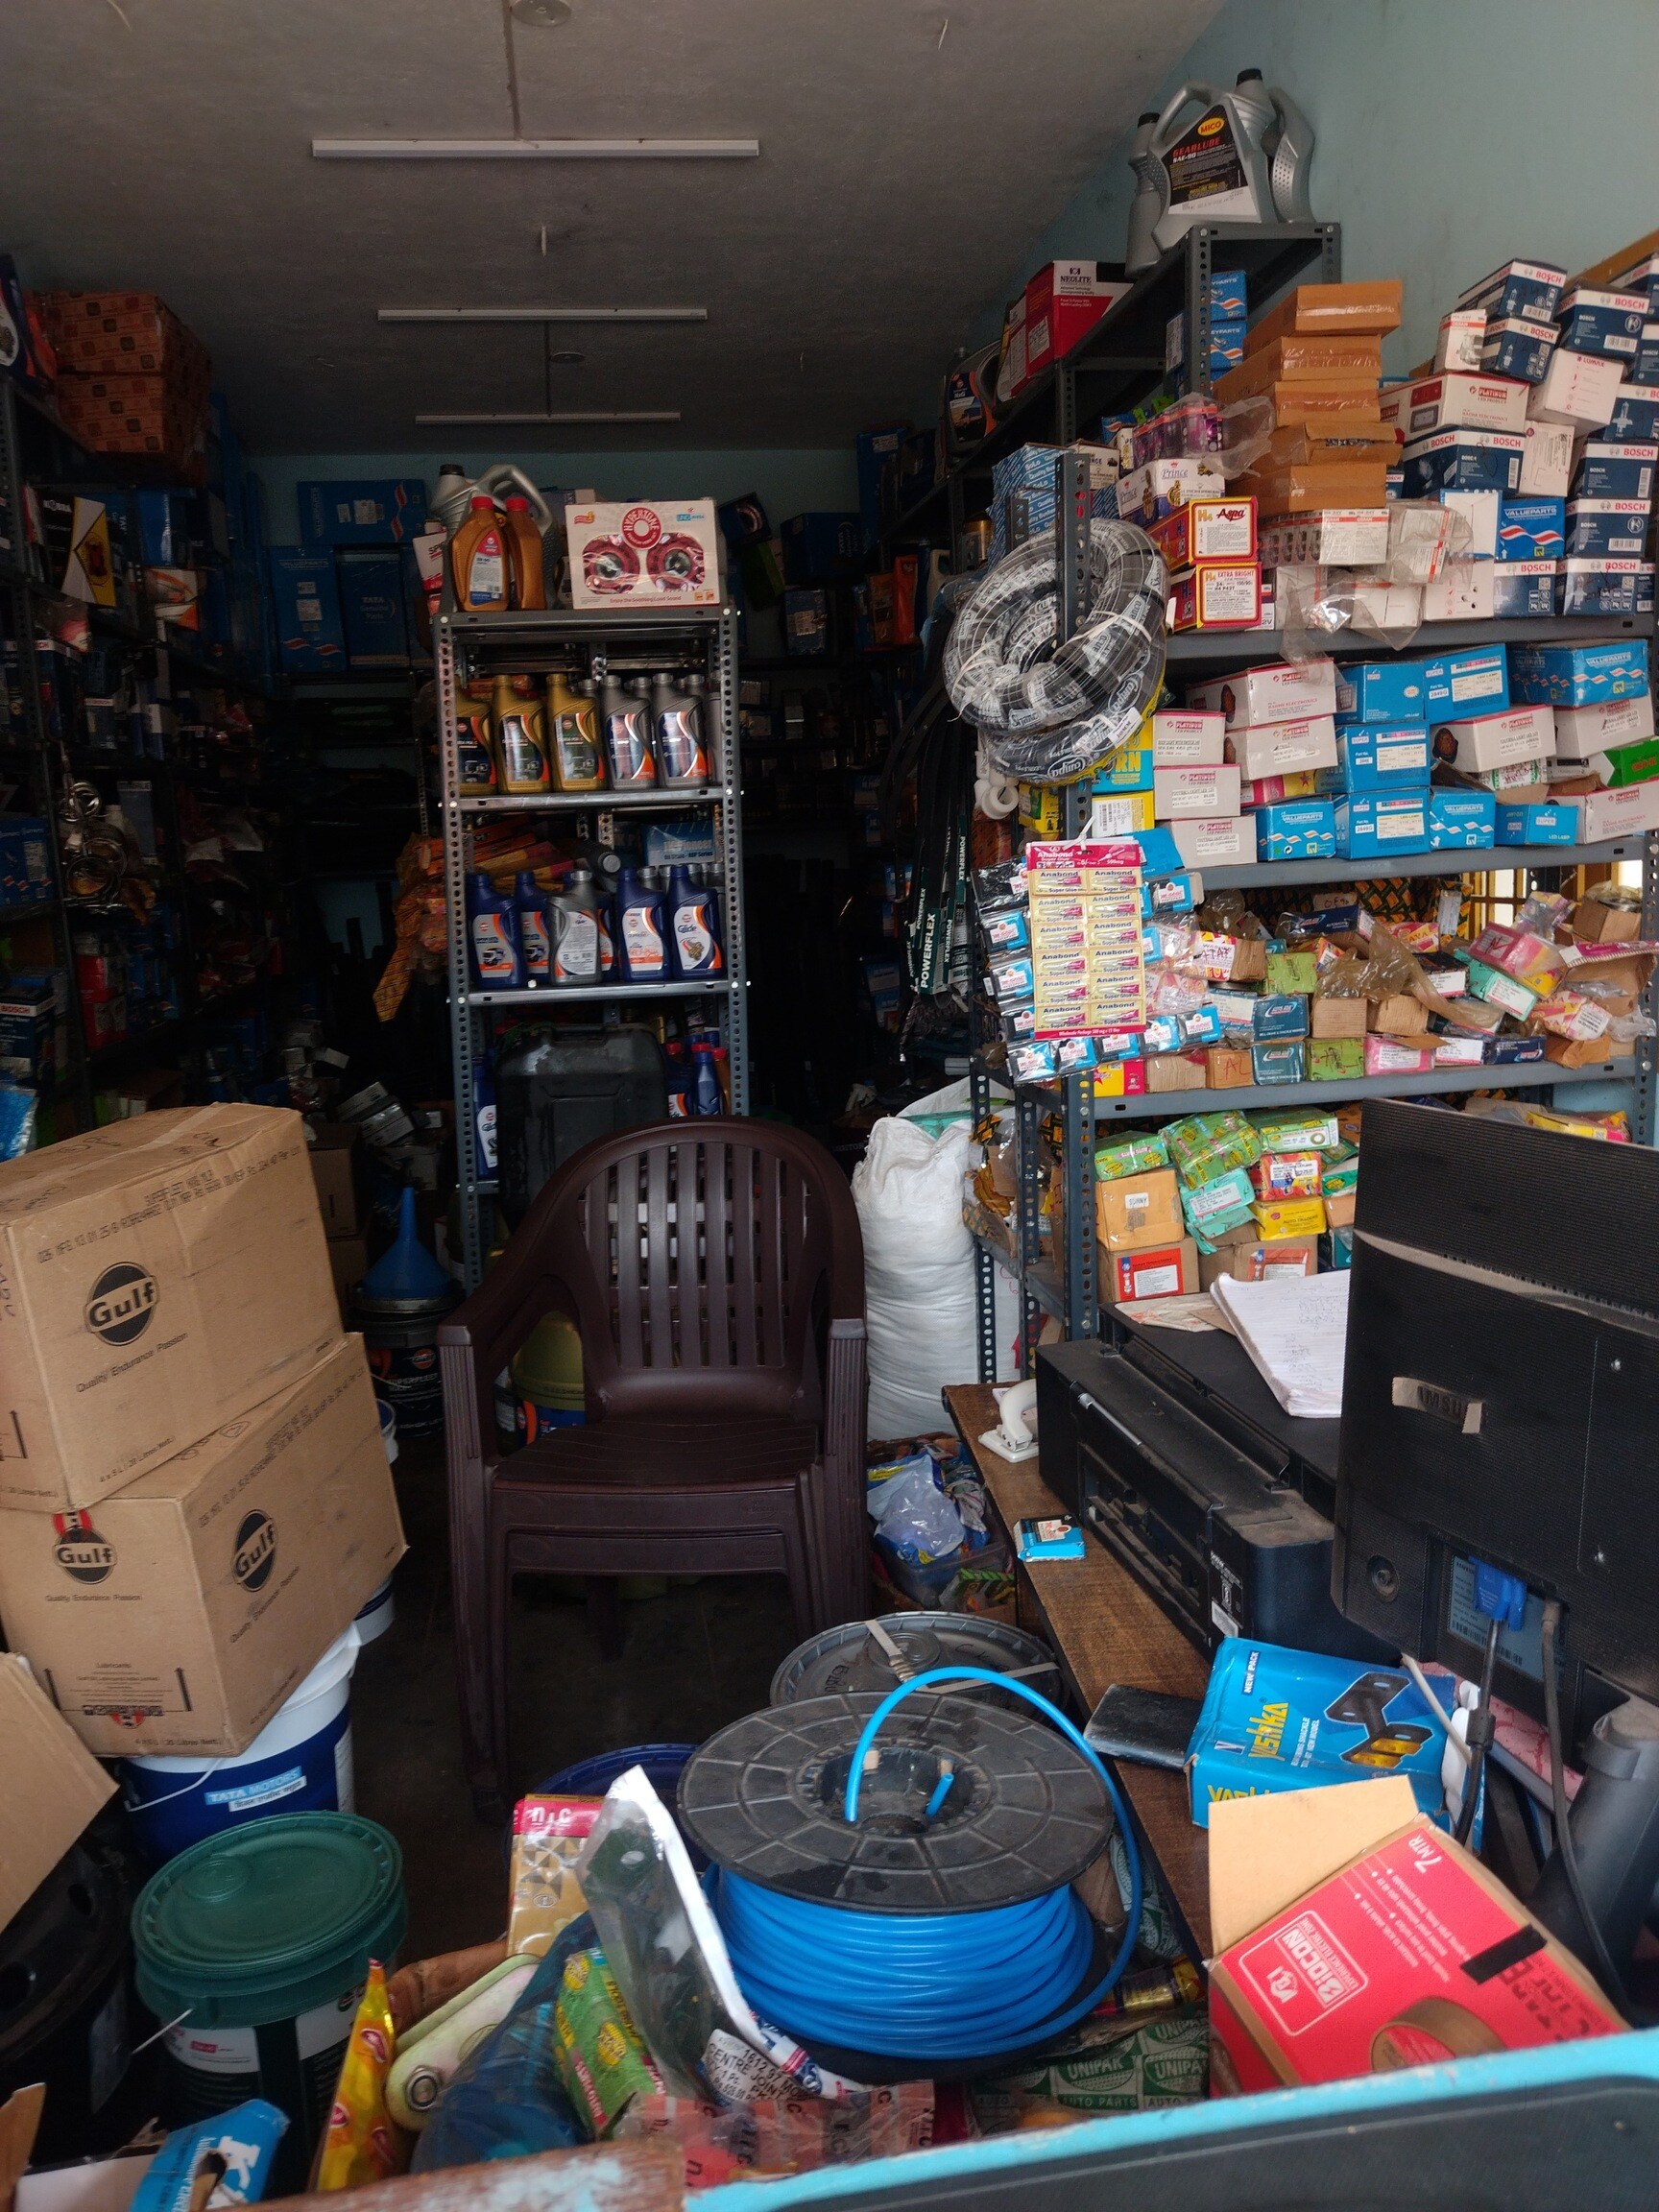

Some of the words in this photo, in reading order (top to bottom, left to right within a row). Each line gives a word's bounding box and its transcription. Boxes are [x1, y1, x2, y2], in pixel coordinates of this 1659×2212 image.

[1200, 122, 1222, 133] MICO
[1172, 136, 1221, 157] GEARLUBE
[1536, 271, 1562, 283] BOSCH
[1615, 298, 1646, 309] BOSCH
[1529, 327, 1554, 340] BOSCH
[1583, 357, 1605, 368] LUMAX
[1479, 388, 1507, 400] PLATINUM
[1431, 435, 1455, 448] BOSCH
[1493, 438, 1522, 447] BOSCH
[1623, 448, 1653, 457] BOSCH
[1025, 460, 1041, 470] SoLo
[1162, 469, 1189, 479] Prince
[1216, 508, 1245, 521] Aspa
[1504, 506, 1557, 517] VALUEPARTS
[1616, 502, 1646, 512] BOSCH
[623, 509, 661, 532] HYPERTONE
[1521, 564, 1551, 573] BOSCH
[1605, 561, 1636, 571] BOSCH
[1113, 674, 1140, 711] Campa
[1175, 720, 1203, 729] PLATINUM
[1282, 726, 1310, 735] PLATINUM
[1050, 757, 1085, 778] Campa
[1115, 752, 1142, 772] RN
[1189, 773, 1216, 781] PLATINUM
[1206, 823, 1233, 831] PLATINUM
[917, 887, 926, 930] POWERFLEX
[944, 919, 952, 963] POWERFLEX
[921, 912, 936, 989] POWERFLEX
[88, 1281, 156, 1328] Gulf
[76, 1372, 108, 1394] Quality
[110, 1349, 155, 1378] Endurance
[156, 1332, 188, 1353] Passion
[57, 1547, 113, 1565] Gulf
[235, 1525, 276, 1577] Gulf
[45, 1594, 71, 1602] Quality
[1248, 1651, 1259, 1674] PACK
[1243, 1674, 1254, 1694] NEW
[209, 1790, 248, 1803] TATA
[249, 1769, 301, 1793] MOTORS
[1408, 1835, 1434, 1861] MTR
[1414, 1855, 1442, 1873] 7
[1299, 1917, 1316, 1936] ZONE
[1309, 1931, 1334, 1959] ELECTRIC
[1328, 1954, 1360, 1990] EXPERIENCE
[708, 2042, 751, 2077] CENTRE
[750, 2072, 785, 2099] JOINT
[742, 2049, 766, 2070] 1612
[766, 2067, 780, 2083] 97
[1067, 2057, 1125, 2080] UNIPAK
[1097, 2094, 1138, 2108] PARTS
